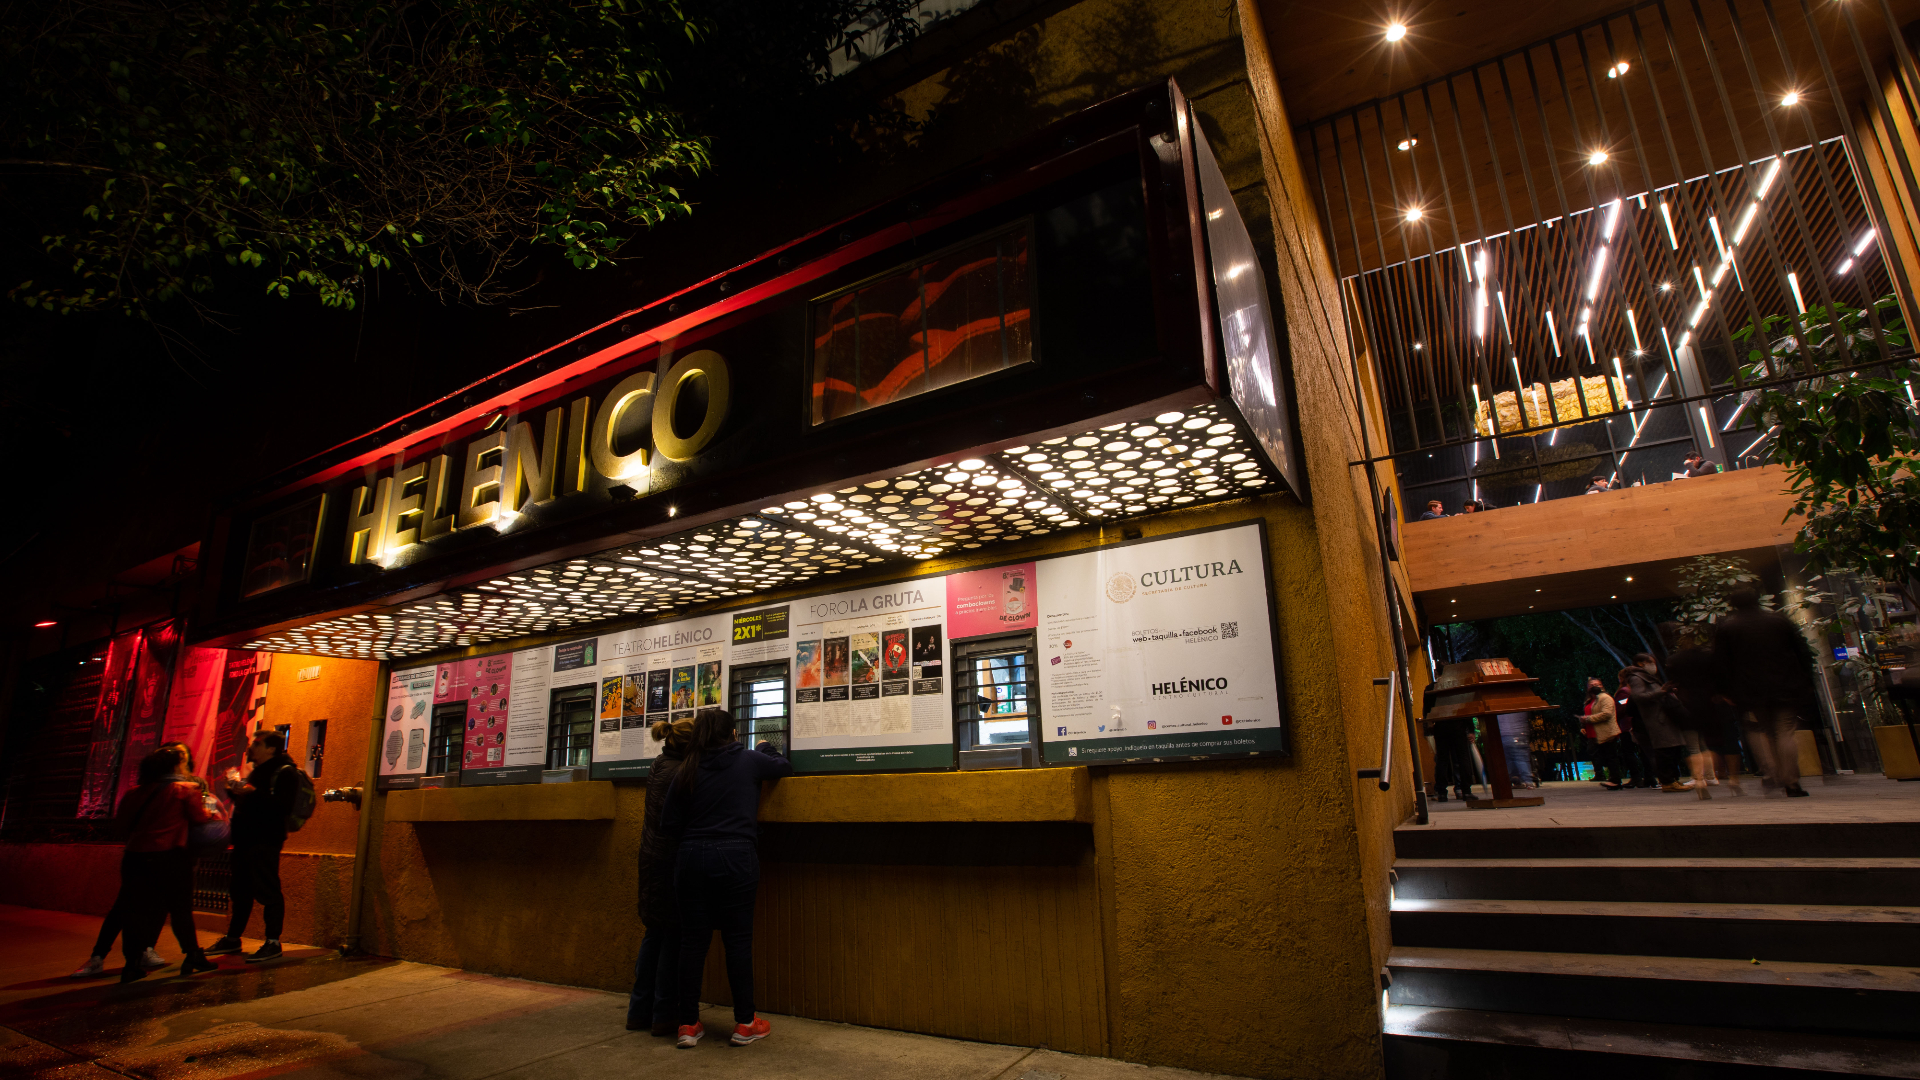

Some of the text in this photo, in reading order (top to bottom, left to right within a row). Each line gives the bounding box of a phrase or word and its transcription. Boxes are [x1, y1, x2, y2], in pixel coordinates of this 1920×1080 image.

[347, 349, 730, 565] HELÉNICO
[1140, 559, 1243, 587] CULTURA
[1183, 582, 1208, 590] CULTURA
[872, 589, 924, 610] GRUTA
[956, 599, 996, 609] comboclowns
[1008, 612, 1031, 621] CLOWN
[1132, 626, 1218, 643] web taquilla facebook
[1151, 676, 1228, 696] HELÉNICO
[1152, 690, 1229, 701] CENTRO CULTURAL
[1155, 742, 1175, 750] taquilla
[1199, 740, 1222, 748] comprar
